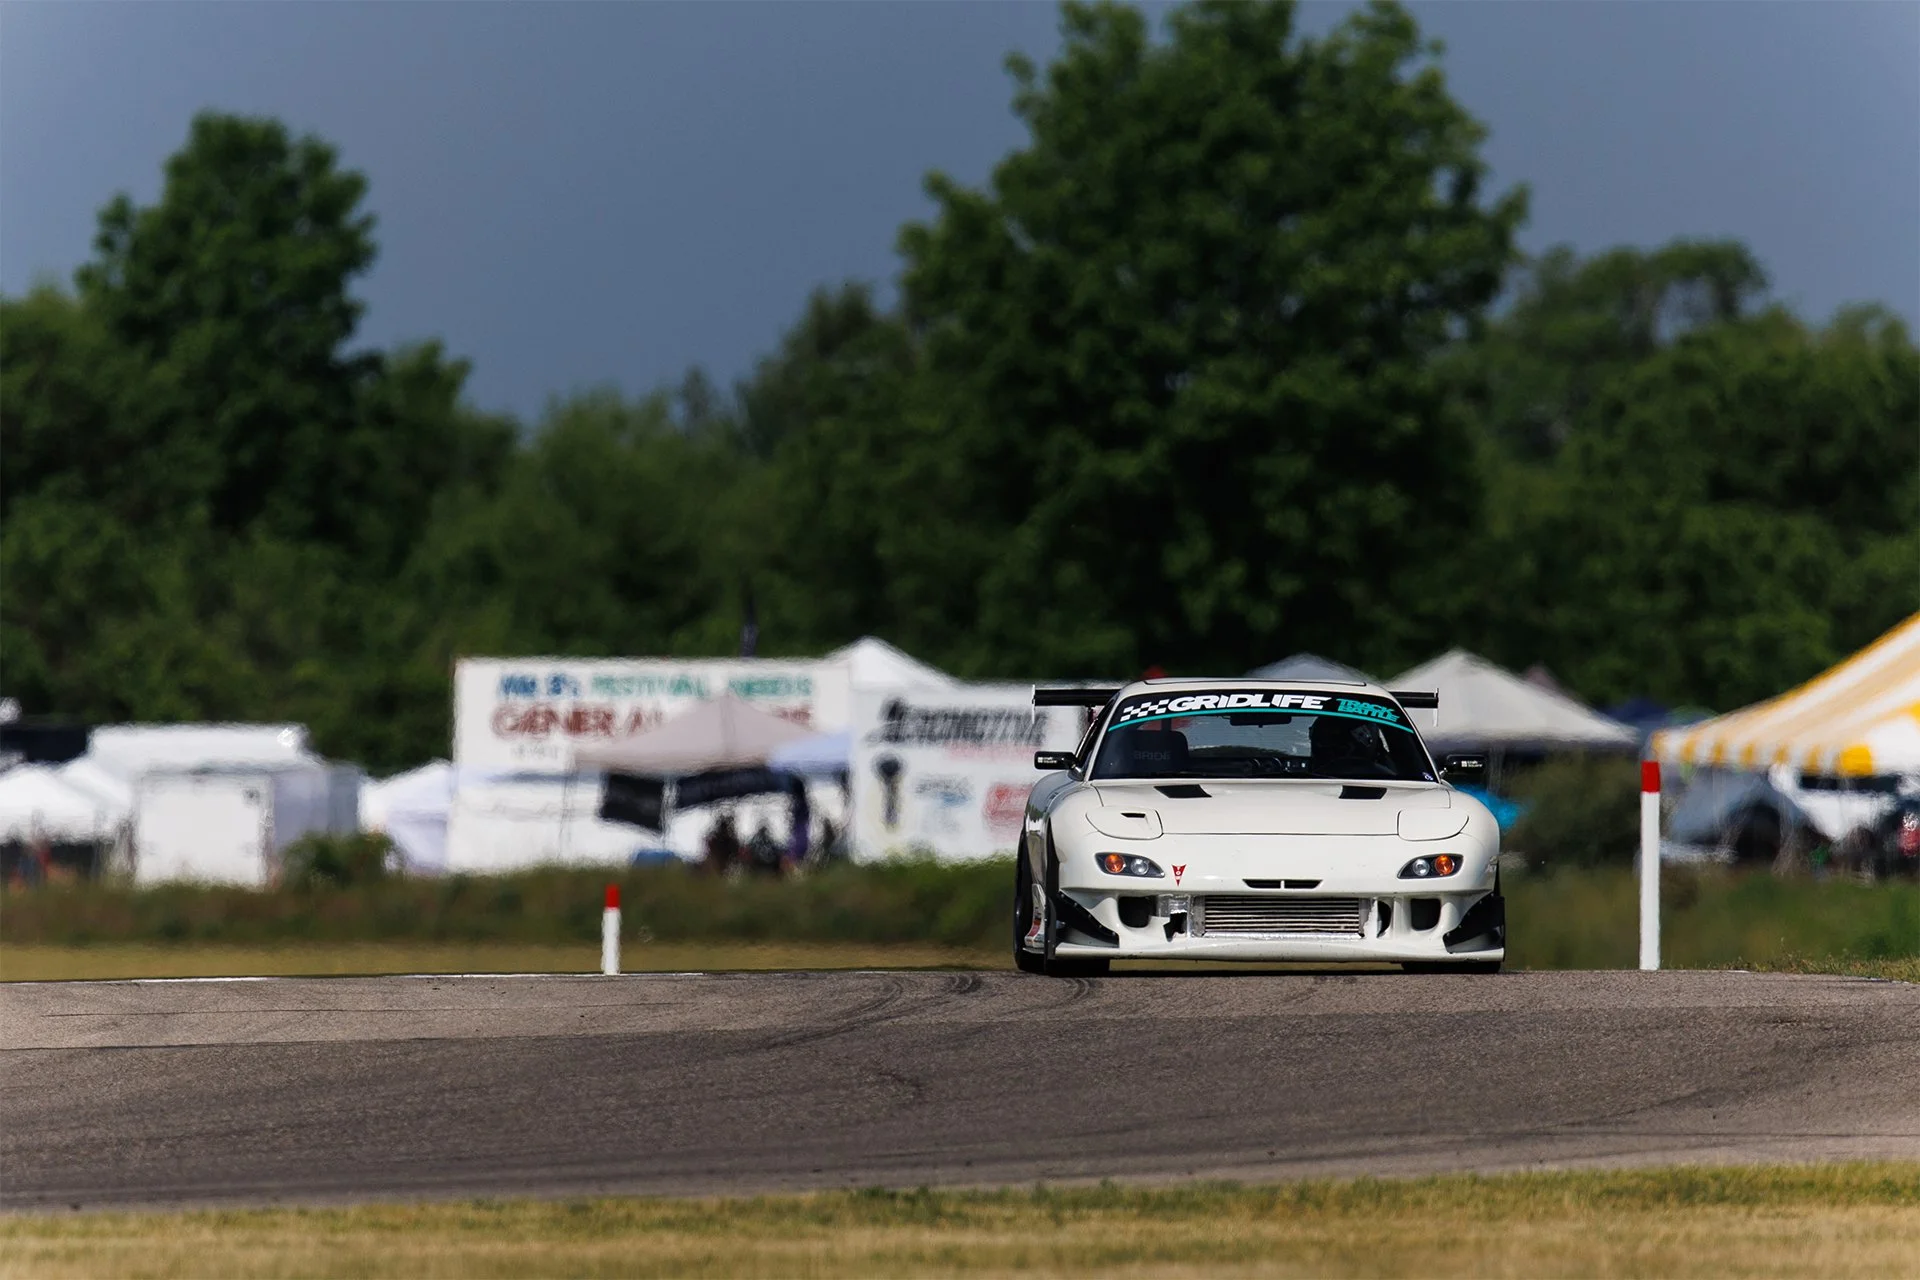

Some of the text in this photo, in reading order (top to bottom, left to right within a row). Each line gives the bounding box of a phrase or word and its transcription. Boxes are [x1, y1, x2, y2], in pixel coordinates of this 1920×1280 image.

[1167, 693, 1332, 712] GRIDLIFE
[1336, 698, 1395, 713] TRACK
[1337, 705, 1400, 722] BATTLE
